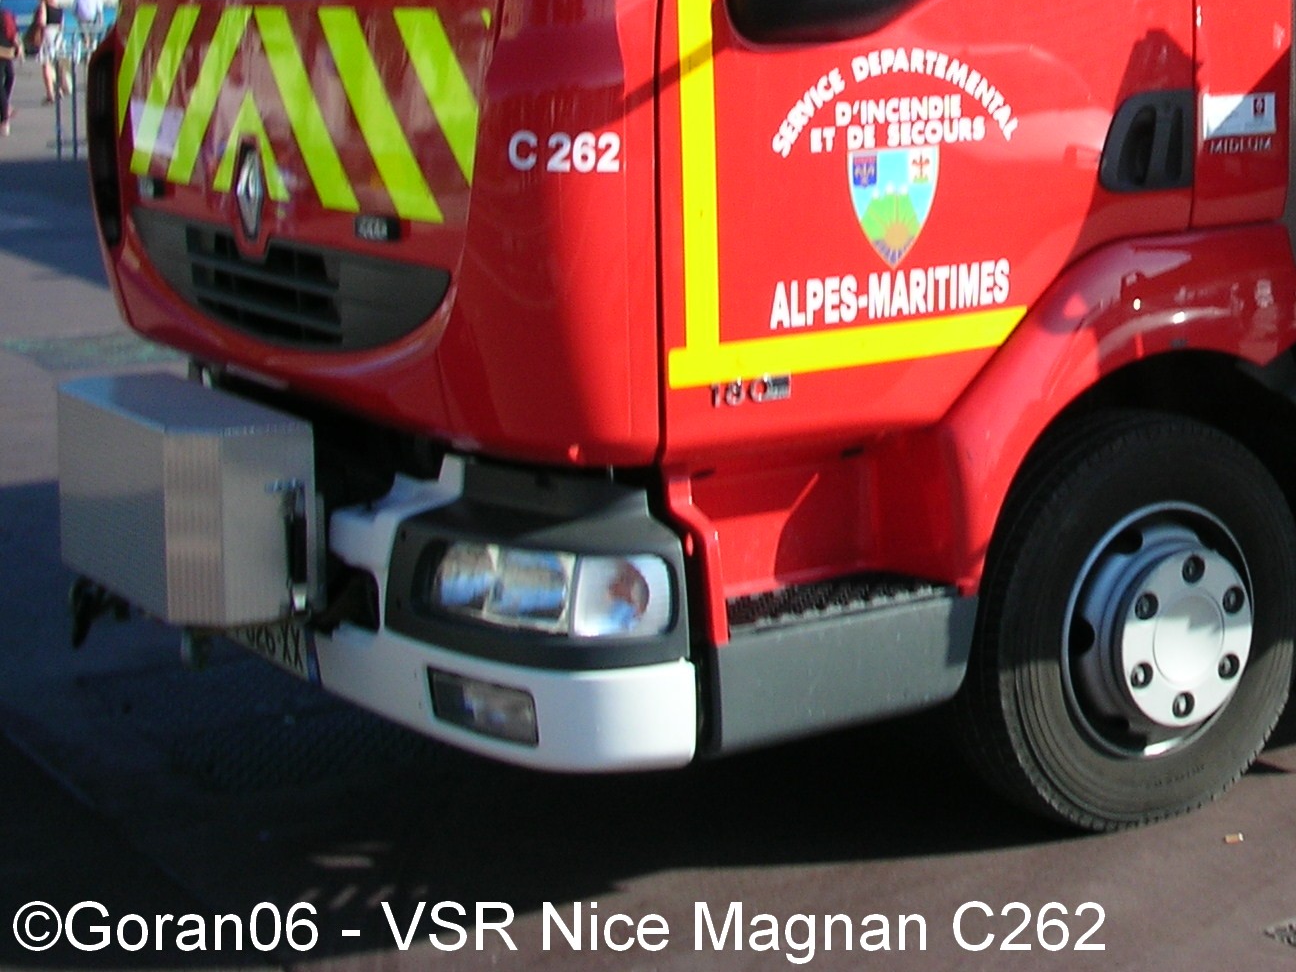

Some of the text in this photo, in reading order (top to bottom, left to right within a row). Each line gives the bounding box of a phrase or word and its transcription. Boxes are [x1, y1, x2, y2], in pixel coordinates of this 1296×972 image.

[771, 47, 1019, 159] SERVICE DEPARTEMENTAL
[835, 93, 962, 127] D'INCENDIE
[508, 129, 621, 174] C 262
[809, 115, 986, 154] ET DE SECOURS
[769, 258, 1011, 330] ALPES-MARITIMES
